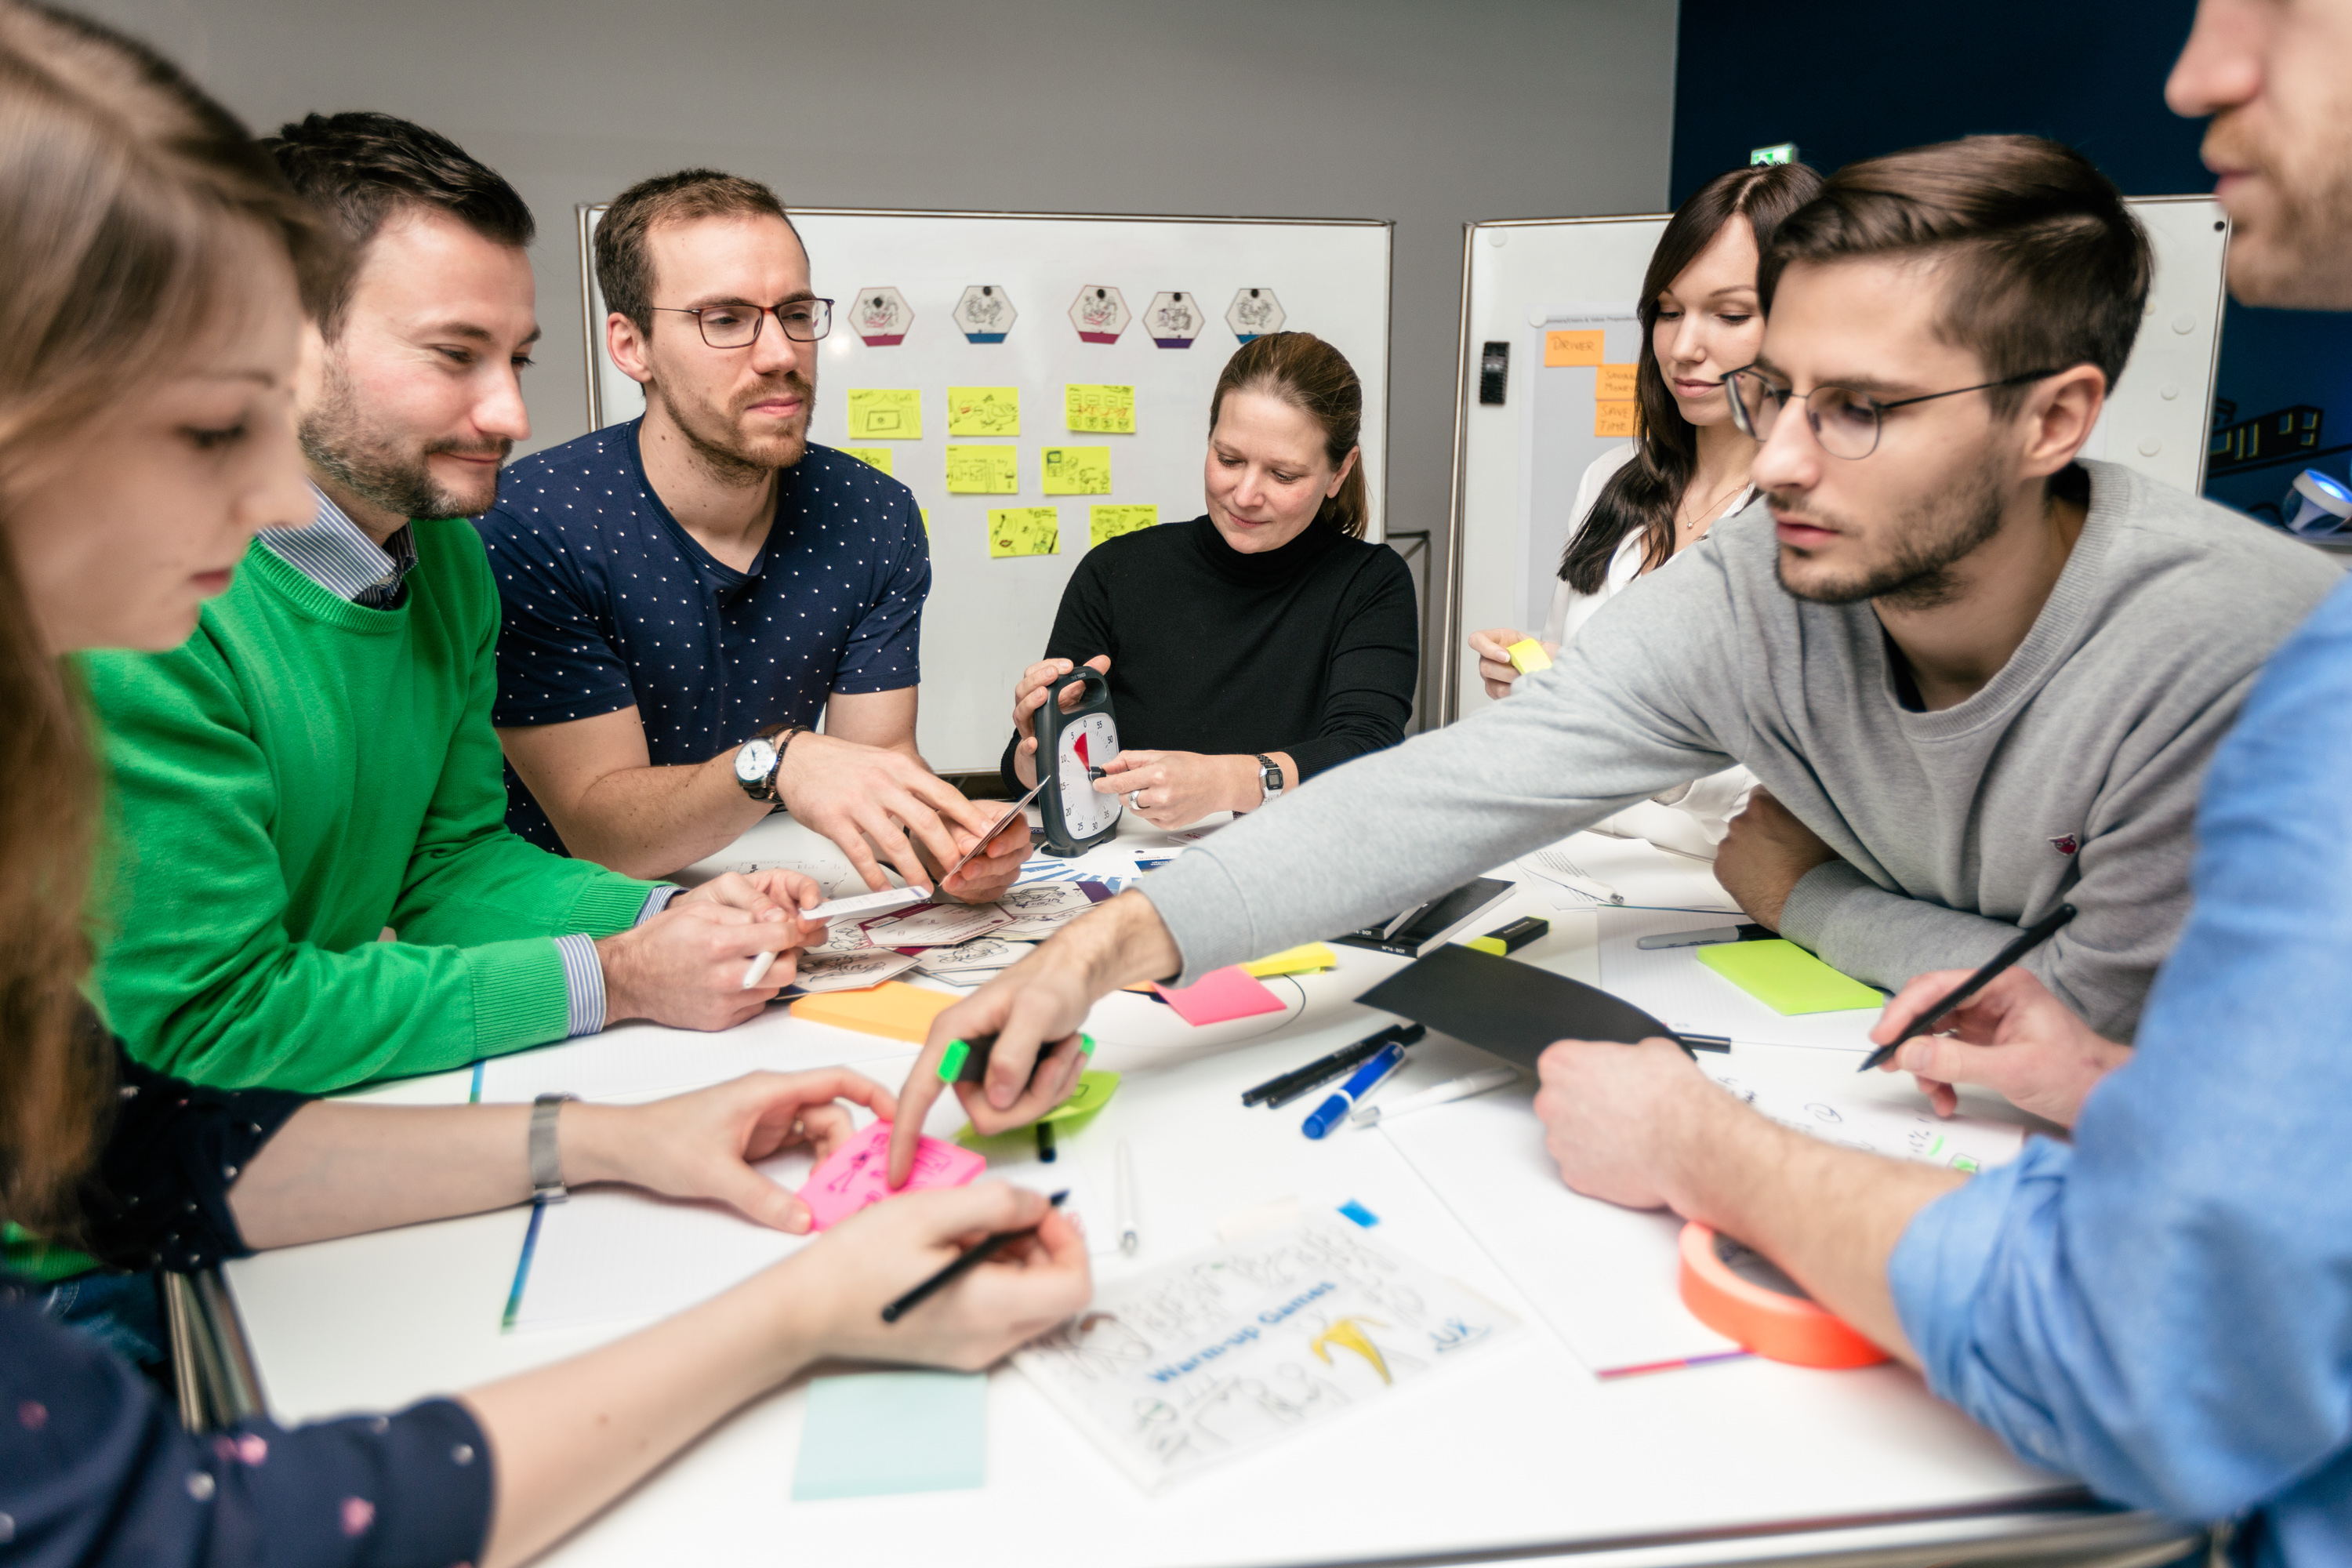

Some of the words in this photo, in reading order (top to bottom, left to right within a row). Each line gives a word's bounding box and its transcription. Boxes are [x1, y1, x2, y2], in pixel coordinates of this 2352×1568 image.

[1551, 336, 1594, 351] DRIVER
[1600, 405, 1630, 418] SAVE
[1599, 420, 1627, 432] TIME
[1083, 720, 1087, 728] 0
[1097, 720, 1103, 729] 55
[1071, 731, 1075, 740] 5
[1108, 735, 1113, 744] 50
[1061, 754, 1067, 764] 10
[1061, 782, 1066, 791] 15
[1065, 808, 1072, 817] 20
[1104, 811, 1110, 819] 35
[1077, 822, 1083, 832] 25
[1092, 822, 1098, 831] 30
[1258, 1281, 1336, 1325] Games
